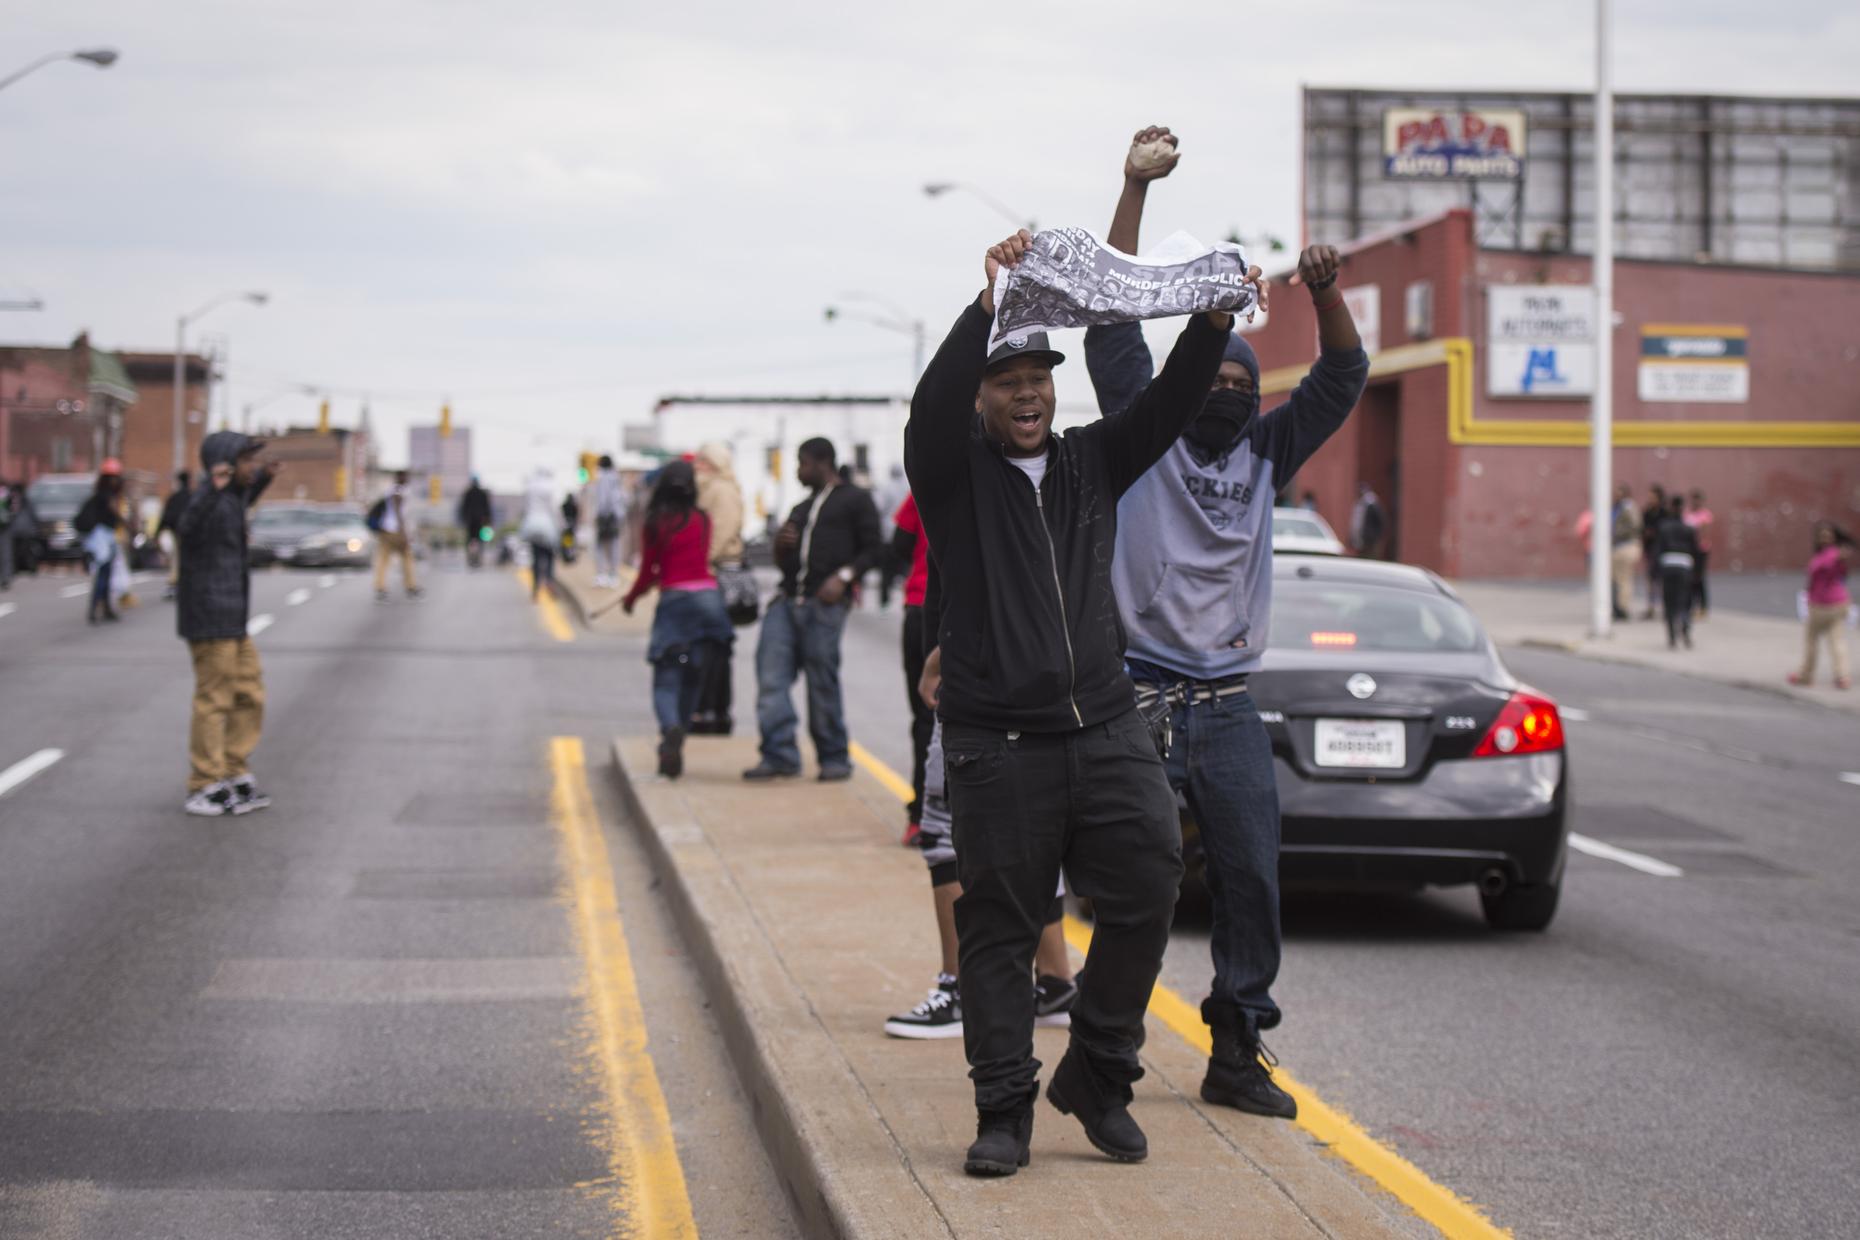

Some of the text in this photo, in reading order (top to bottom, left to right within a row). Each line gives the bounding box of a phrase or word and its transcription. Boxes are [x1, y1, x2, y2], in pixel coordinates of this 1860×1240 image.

[1129, 253, 1238, 282] STOP
[1198, 272, 1246, 287] POLIC
[1181, 474, 1253, 506] CKIES
